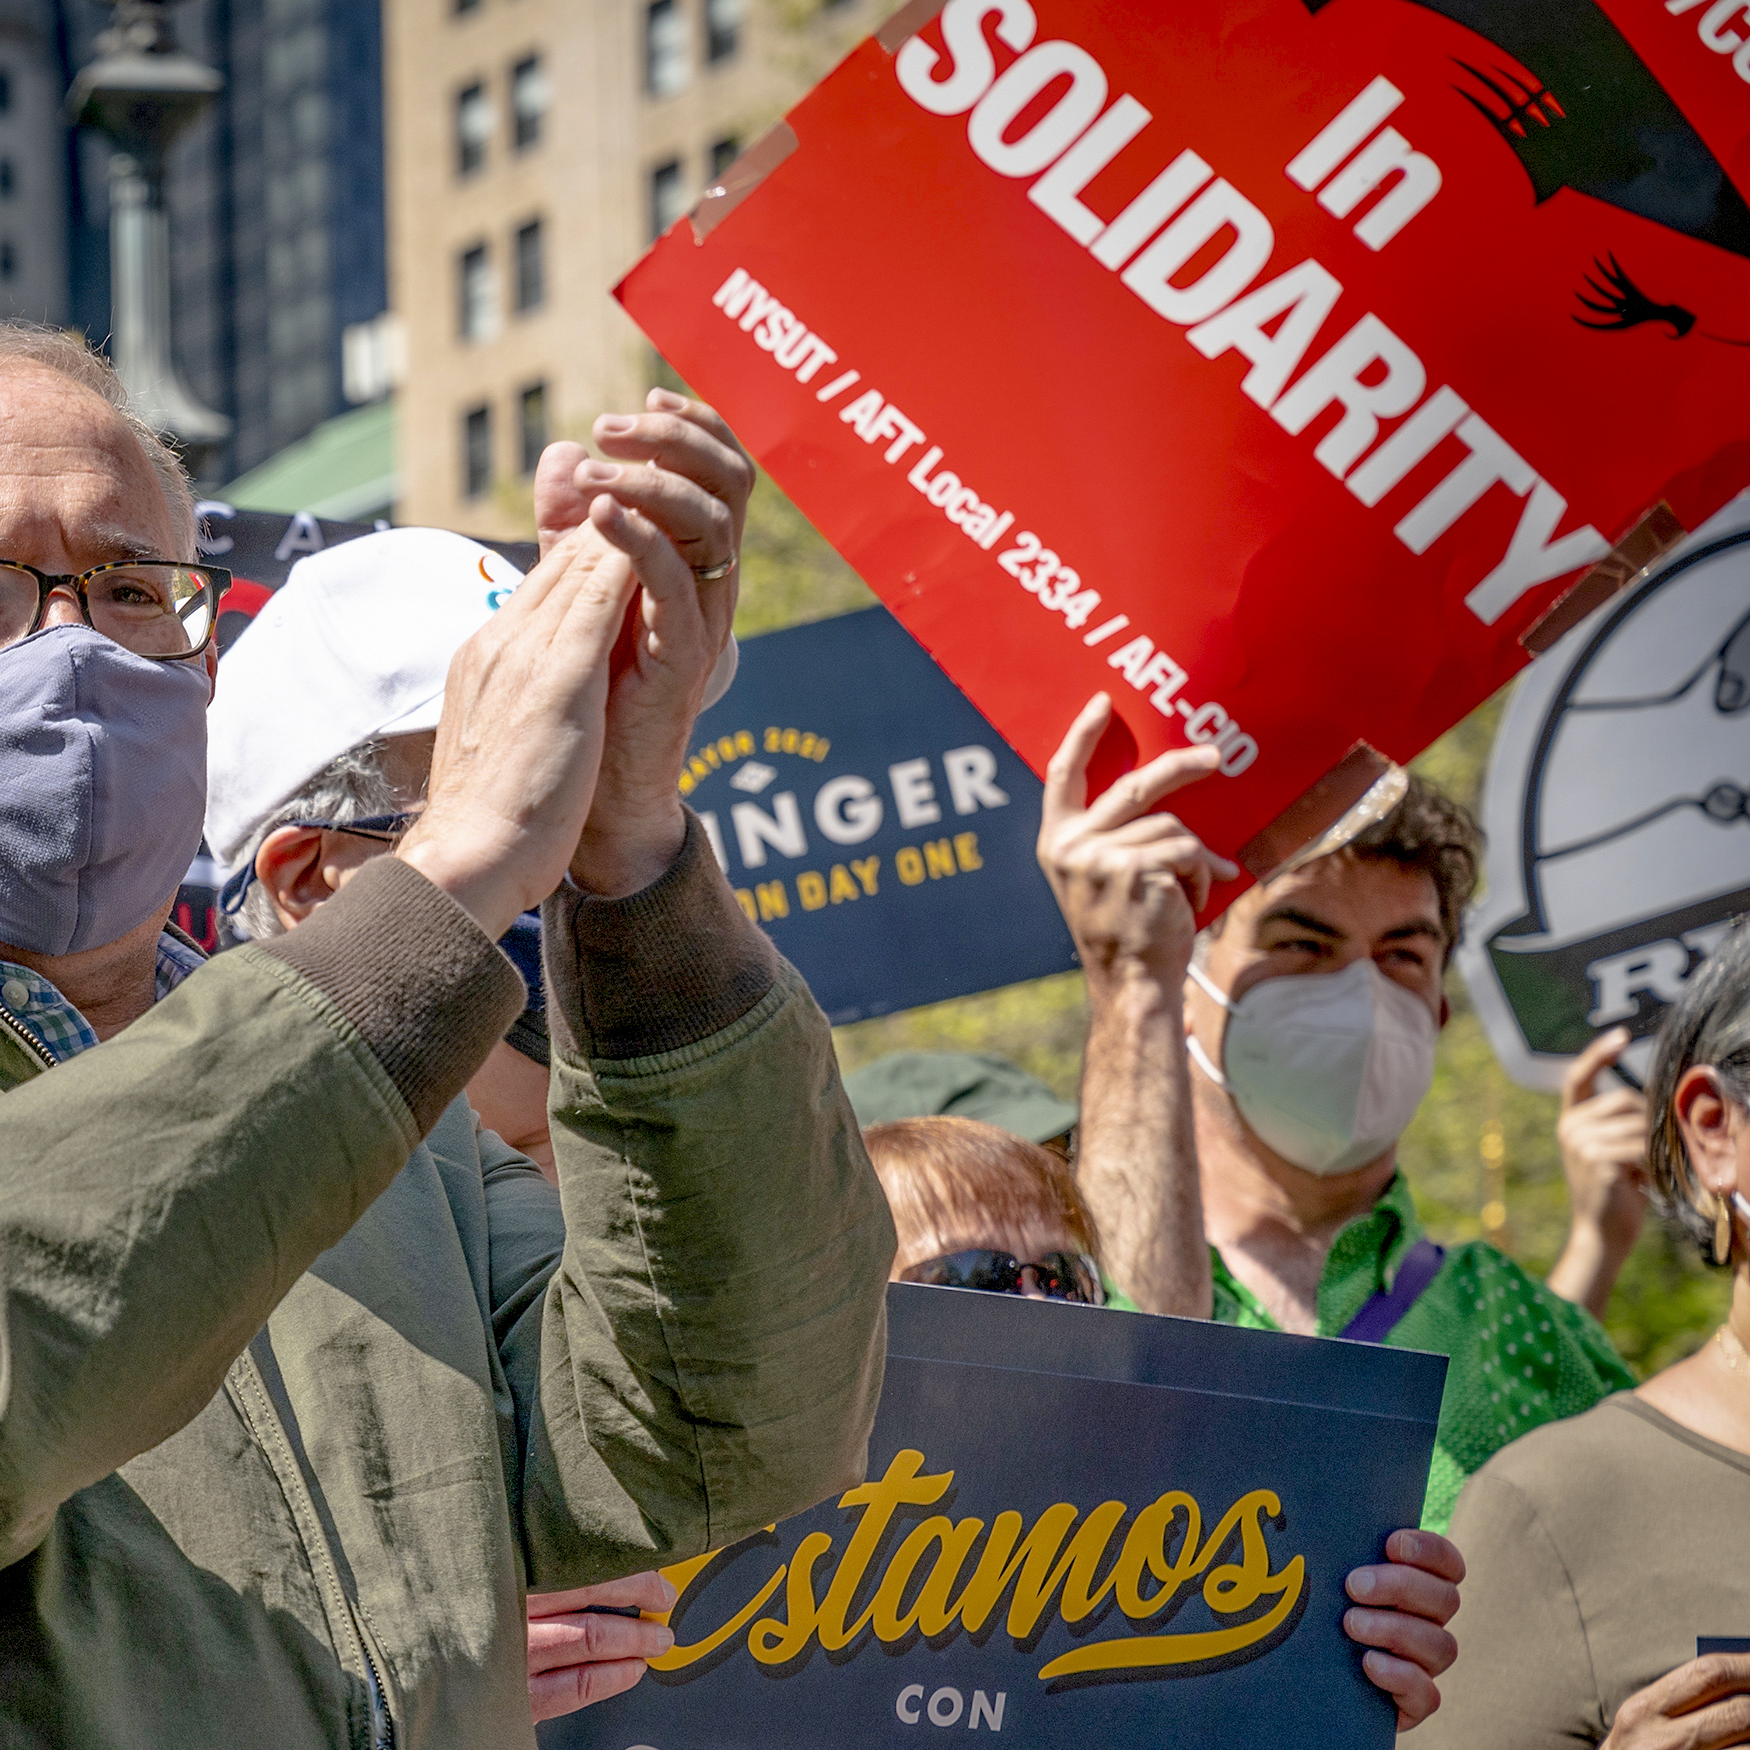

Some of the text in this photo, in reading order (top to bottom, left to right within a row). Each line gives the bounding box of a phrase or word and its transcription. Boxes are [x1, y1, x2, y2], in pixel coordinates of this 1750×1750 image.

[1284, 74, 1443, 253] In
[895, 0, 1613, 626] SOLIDARITY
[712, 266, 838, 384] NYSUT
[839, 388, 927, 464] AFT
[907, 444, 1015, 550] Local
[997, 530, 1102, 630] 2334
[1107, 634, 1259, 778] AFL-CIO
[795, 854, 881, 912] DAY
[894, 831, 985, 886] ONE
[895, 1683, 1007, 1732] CON
